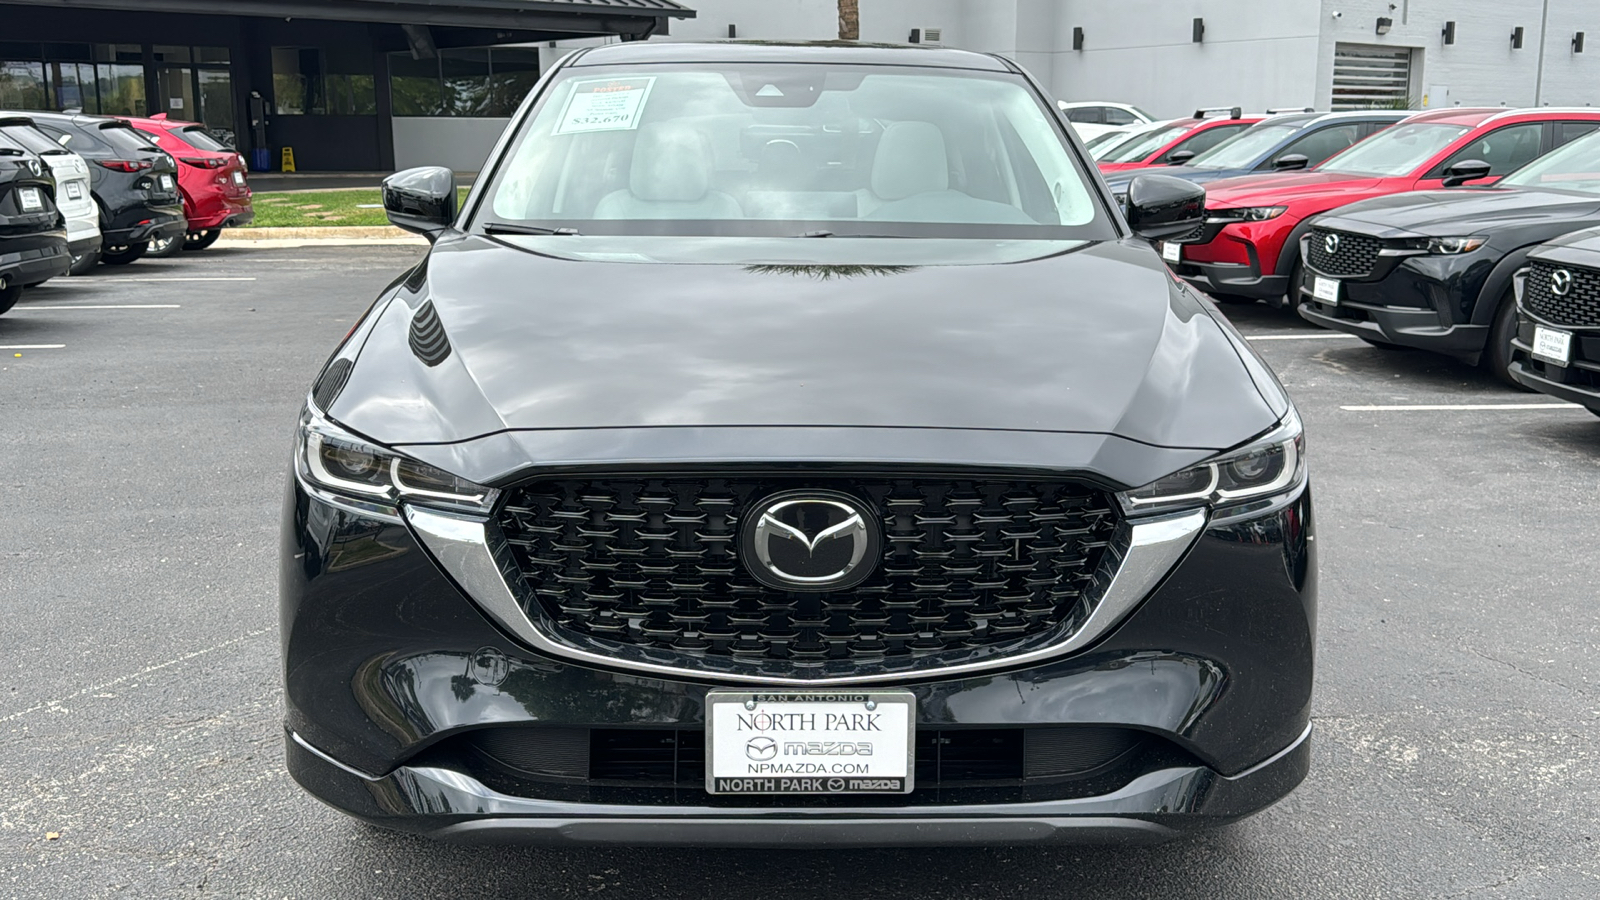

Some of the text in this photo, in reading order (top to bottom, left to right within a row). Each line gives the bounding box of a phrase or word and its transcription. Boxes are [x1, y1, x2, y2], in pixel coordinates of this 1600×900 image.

[572, 114, 629, 125] $32,670
[757, 694, 865, 702] SAN ANTONIO
[736, 712, 882, 731] NORTH PARK
[784, 741, 873, 756] mazda
[748, 763, 869, 774] NPMAZDA.COM
[719, 779, 900, 791] NORTH PARK mazda
